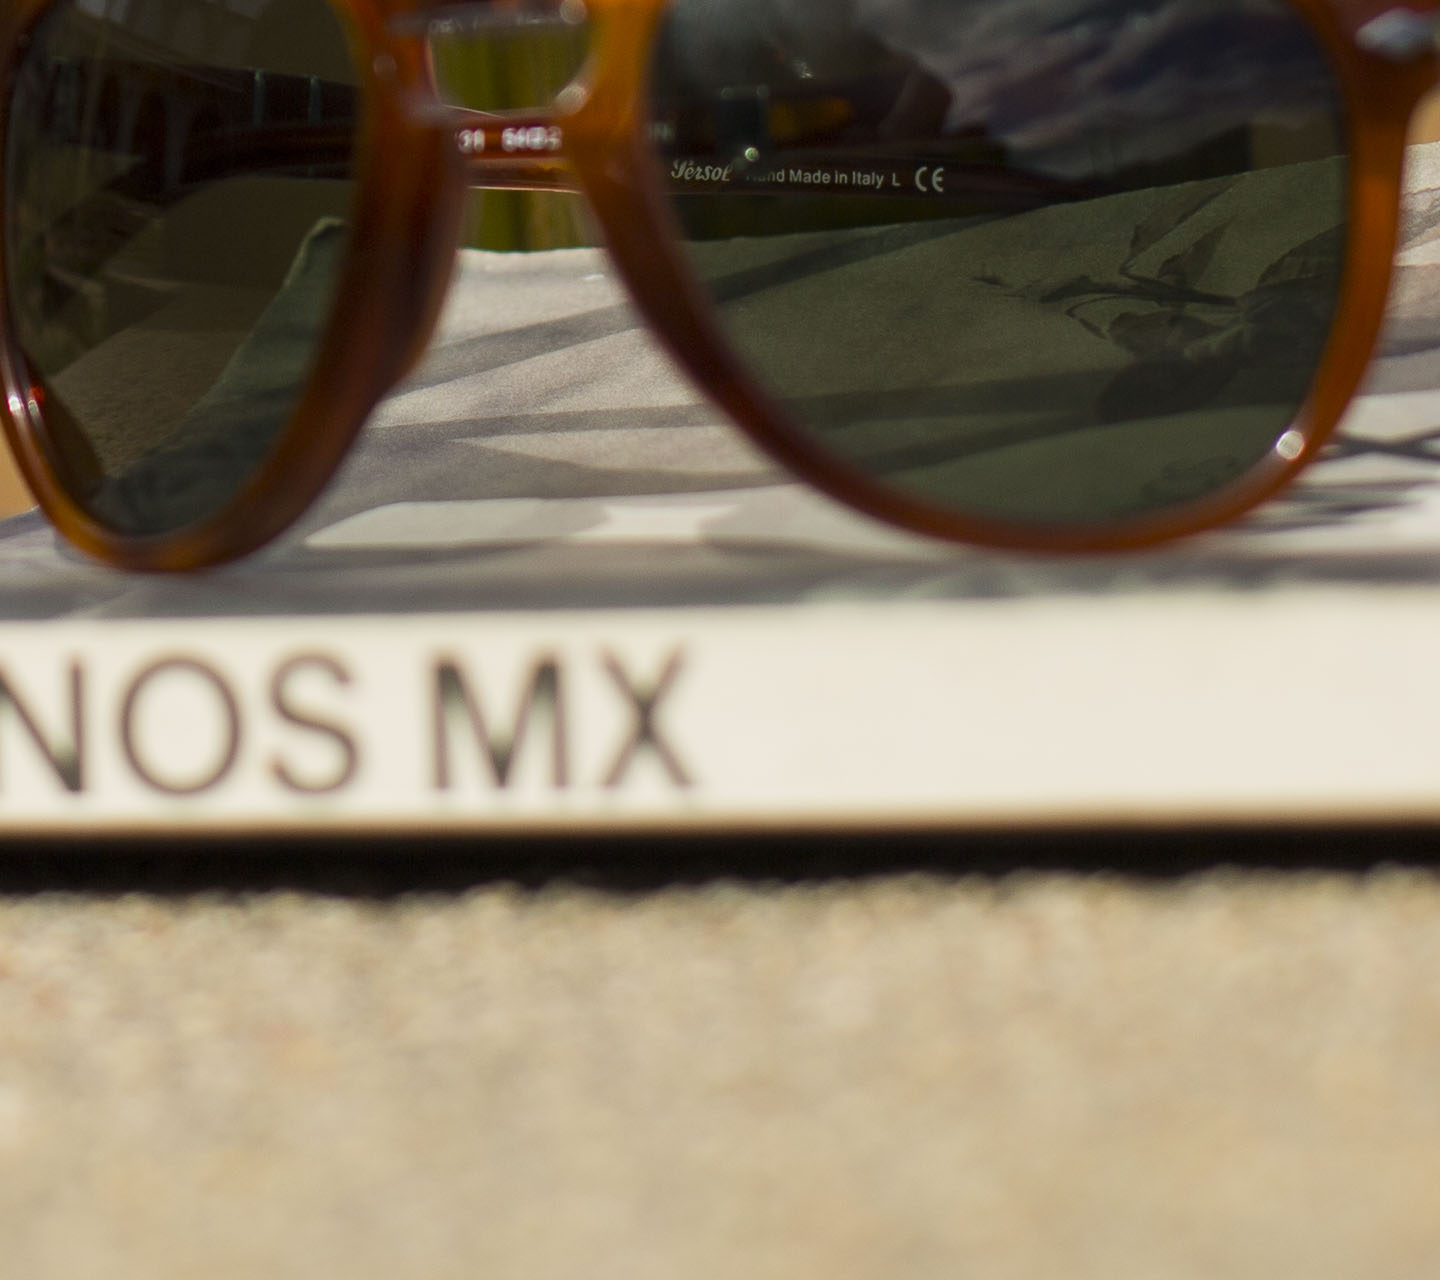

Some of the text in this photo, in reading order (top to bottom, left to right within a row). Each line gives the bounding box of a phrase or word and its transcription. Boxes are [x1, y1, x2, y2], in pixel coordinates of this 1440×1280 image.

[788, 169, 831, 185] Made
[834, 169, 848, 185] in
[851, 169, 884, 190] Italy
[426, 646, 700, 795] MX
